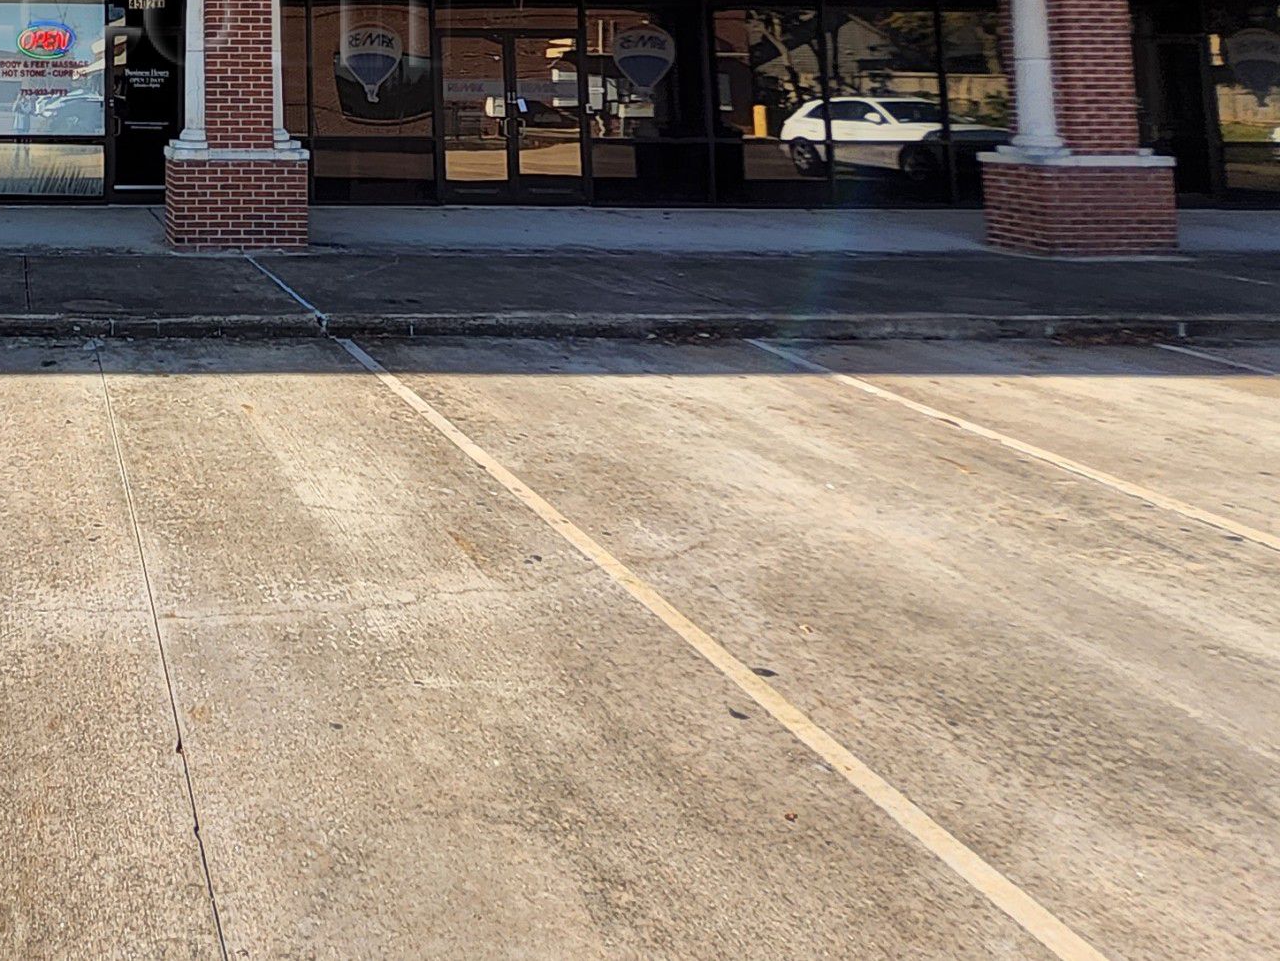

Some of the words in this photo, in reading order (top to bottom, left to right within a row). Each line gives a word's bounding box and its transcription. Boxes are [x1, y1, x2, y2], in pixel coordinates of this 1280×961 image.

[21, 30, 70, 51] OPEN
[30, 60, 50, 68] FEET
[20, 69, 46, 78] STONE
